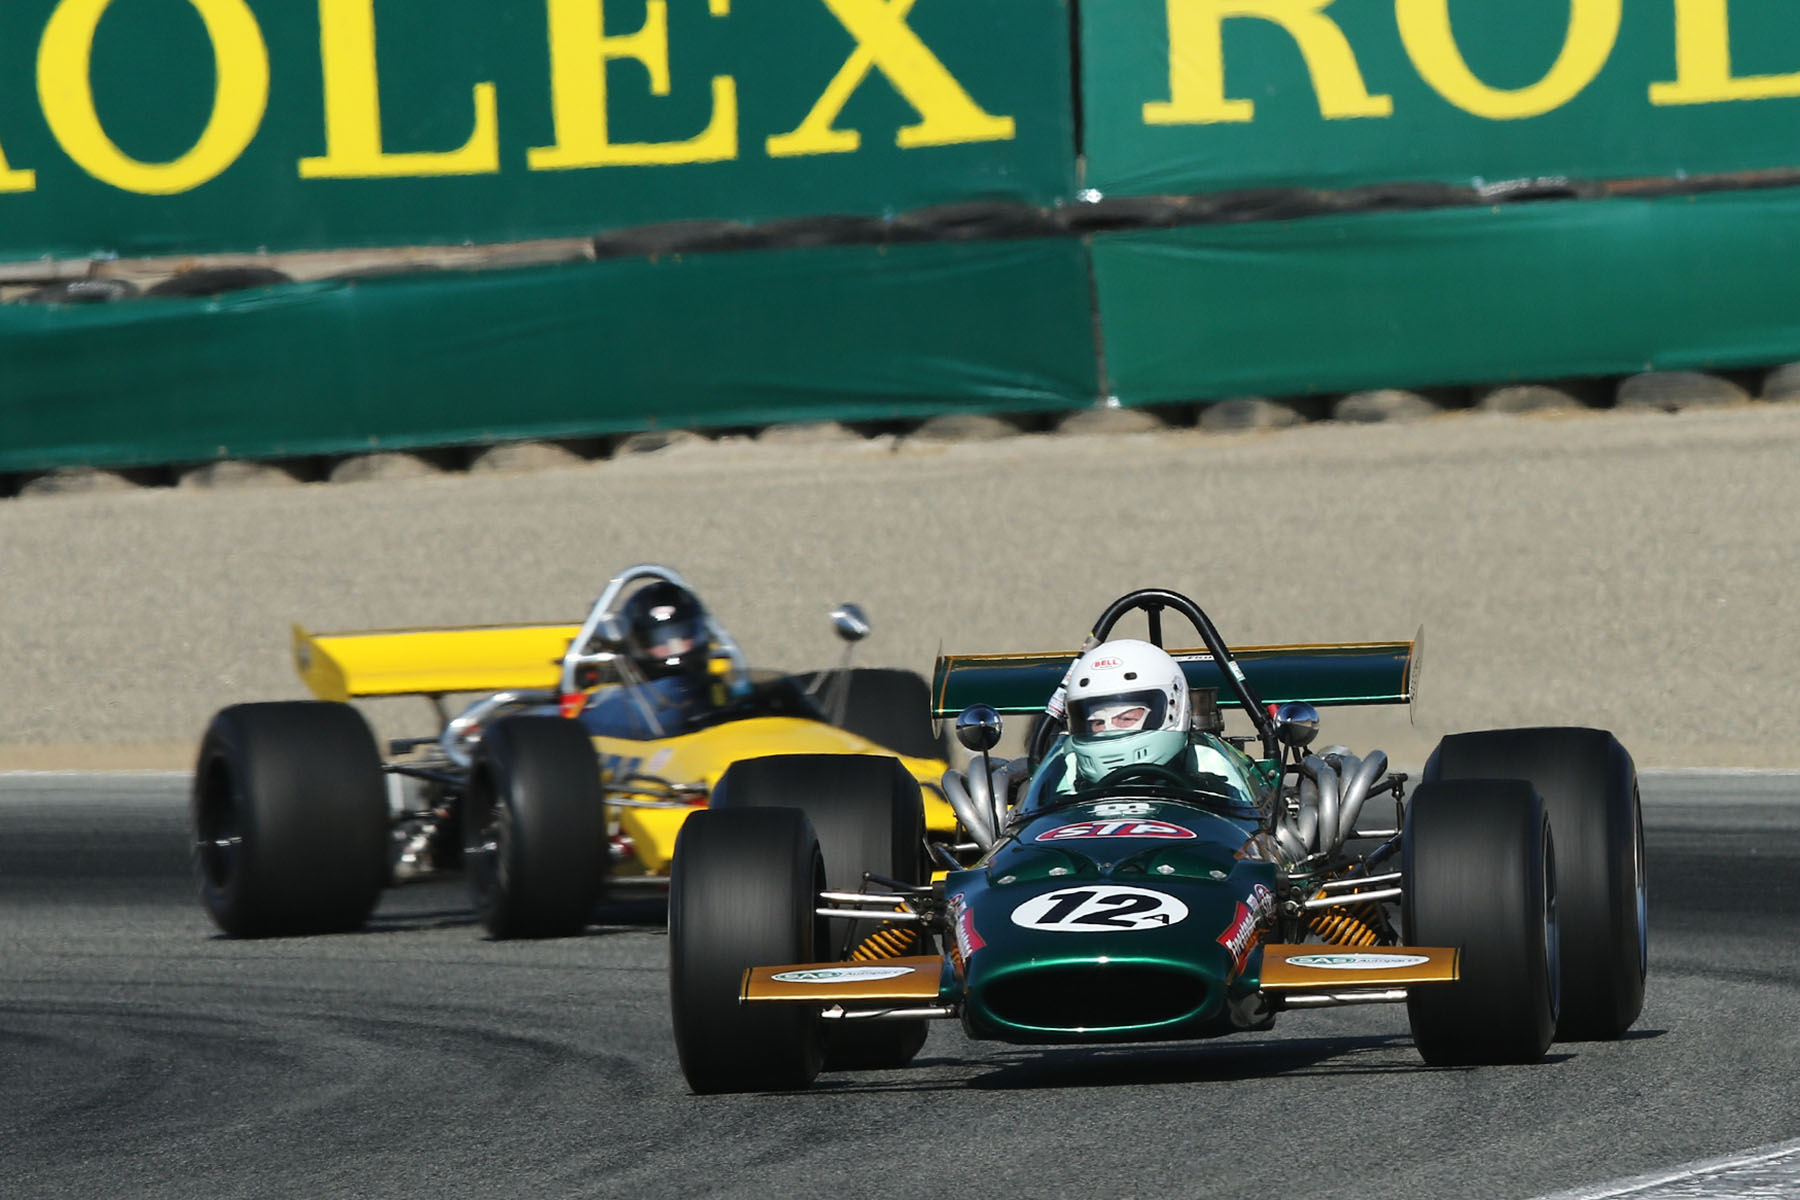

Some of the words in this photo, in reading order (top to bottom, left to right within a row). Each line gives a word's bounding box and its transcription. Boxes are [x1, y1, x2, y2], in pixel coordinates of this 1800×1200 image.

[0, 0, 1015, 195] OLEX
[1094, 658, 1119, 668] BELL
[1053, 821, 1178, 838] STP
